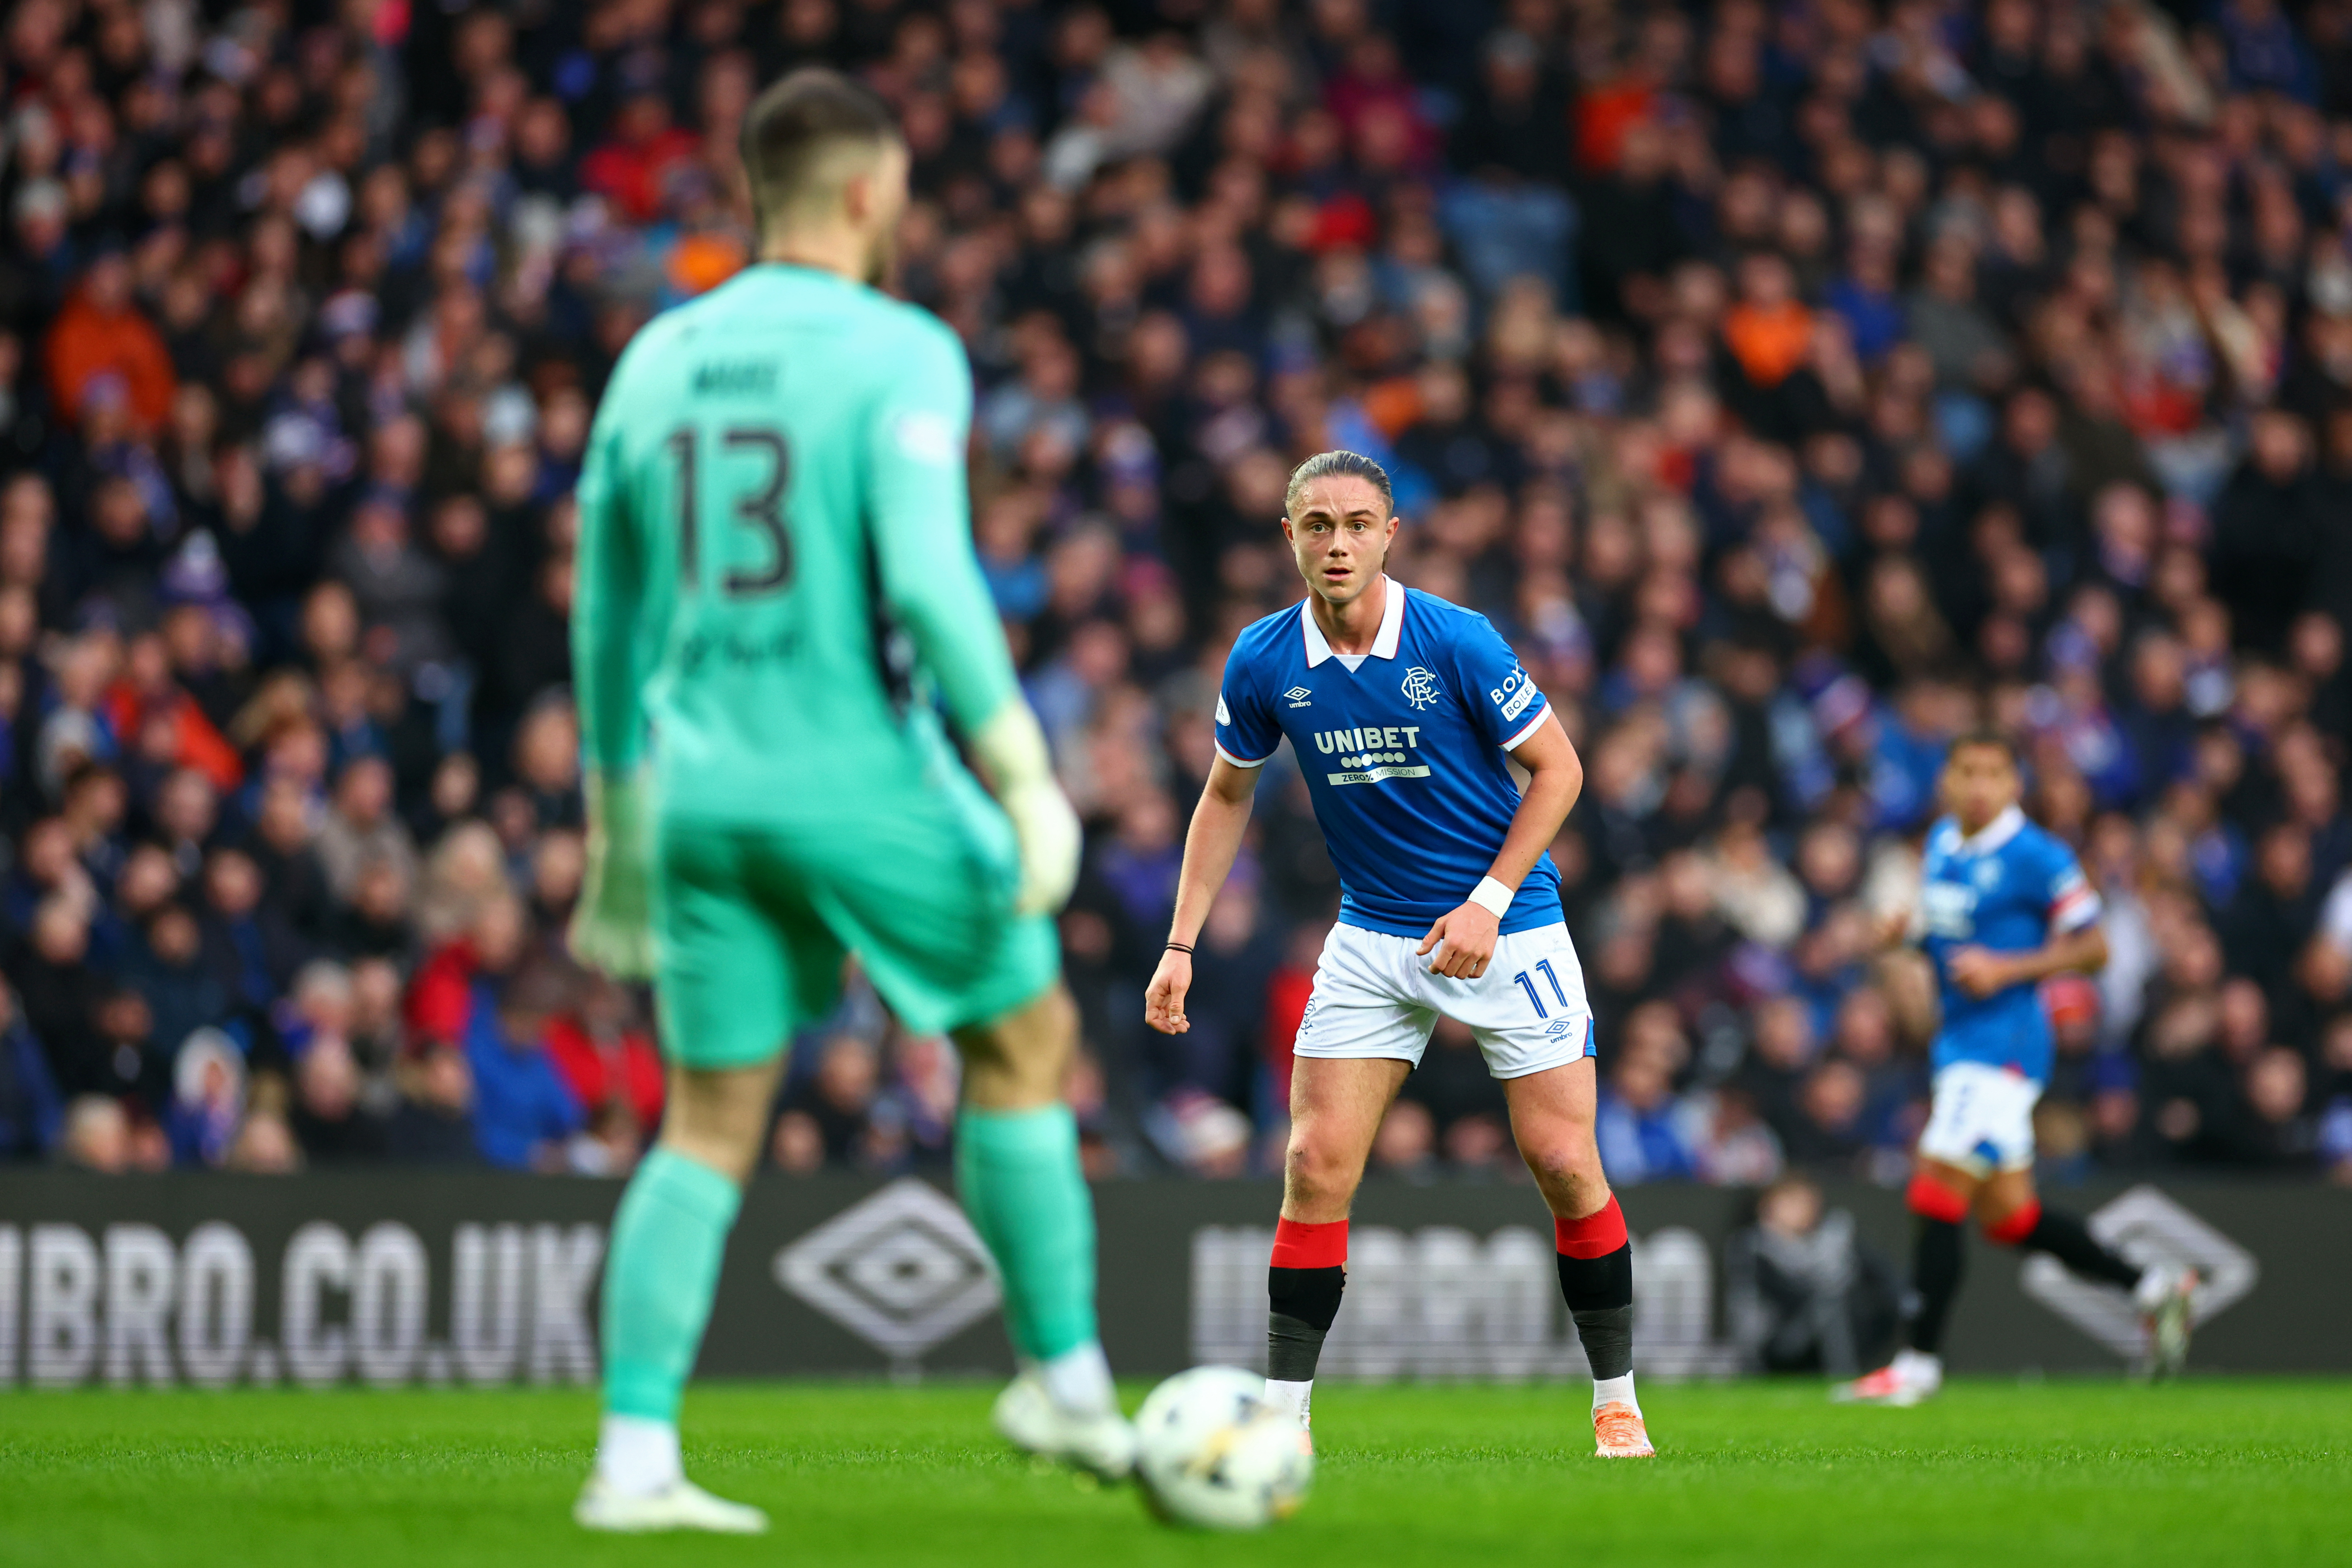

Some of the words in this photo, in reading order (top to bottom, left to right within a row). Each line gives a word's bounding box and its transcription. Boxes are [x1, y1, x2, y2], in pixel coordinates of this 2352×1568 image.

[666, 422, 794, 598] 13
[1314, 727, 1419, 754] UNIBET
[1376, 768, 1415, 778] MISSION
[1514, 958, 1568, 1019] 11
[1551, 1032, 1572, 1043] umbro
[0, 1221, 604, 1387] BRO.CO.UK
